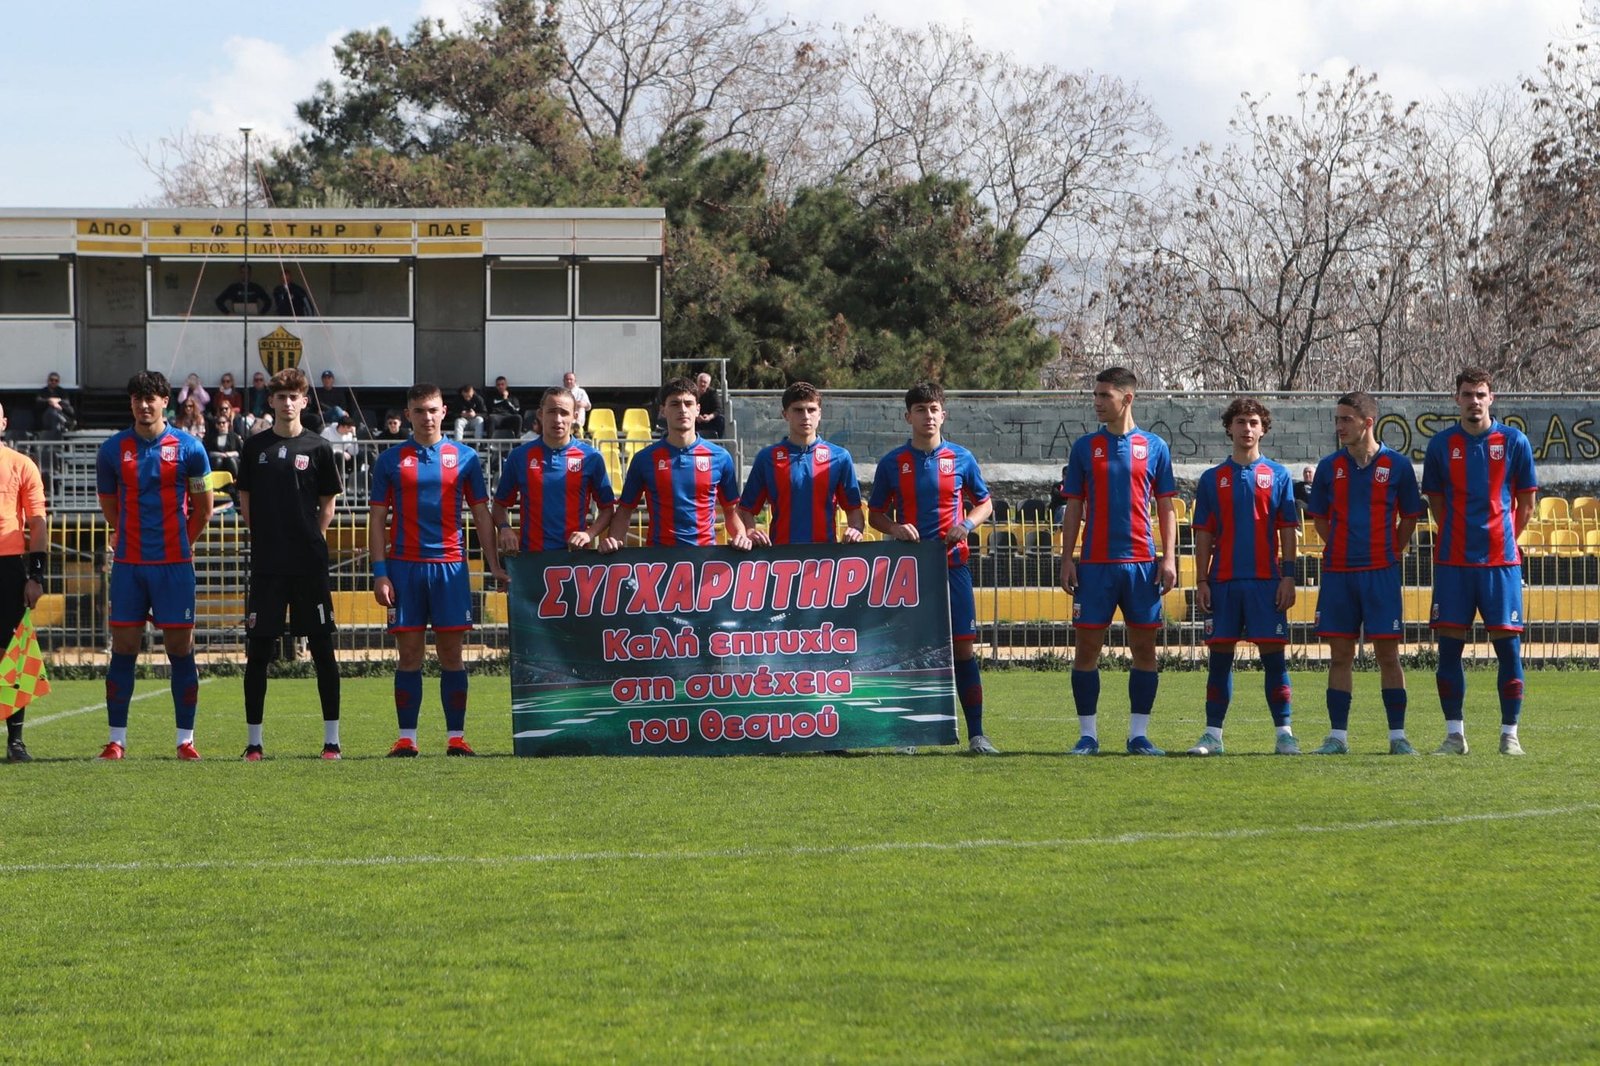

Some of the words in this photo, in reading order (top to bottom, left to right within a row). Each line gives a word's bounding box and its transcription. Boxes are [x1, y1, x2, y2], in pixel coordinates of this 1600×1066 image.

[189, 242, 230, 254] ΕΤΟΣ
[253, 242, 329, 255] ΙΔΡΥΣΕΩΣ
[342, 243, 376, 254] 1926
[210, 223, 346, 237] ΦΩΣΤΗΡ
[1004, 420, 1198, 457] TAOS
[538, 556, 920, 619] ΣΥΓΧΑΡΗΤΗΡΙΑ
[317, 603, 326, 625] 1
[603, 626, 699, 661] Καλή
[709, 622, 857, 657] επιτυχία
[611, 676, 675, 702] στη
[684, 665, 852, 699] συνέχεια
[628, 718, 690, 744] του
[698, 705, 839, 742] θεσμού
